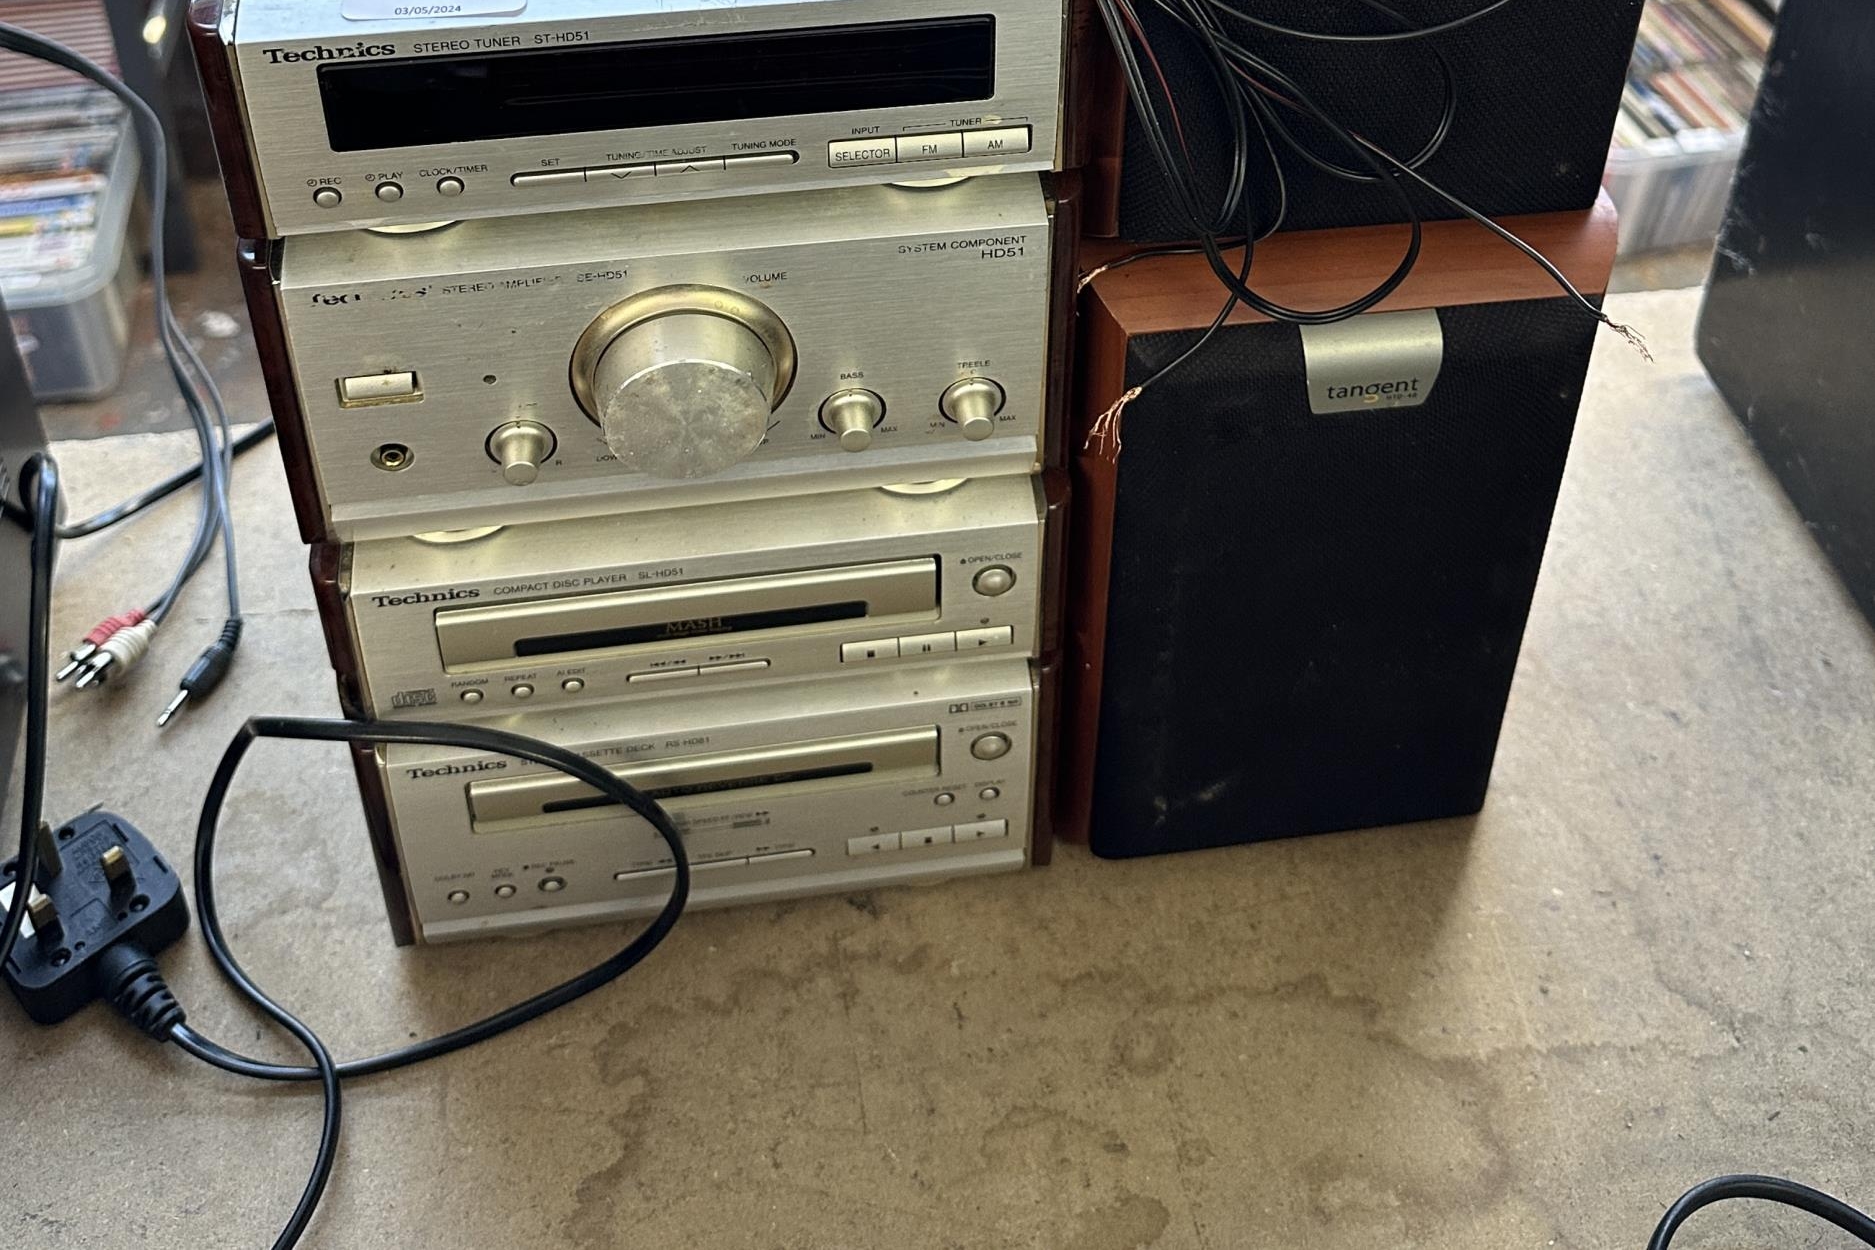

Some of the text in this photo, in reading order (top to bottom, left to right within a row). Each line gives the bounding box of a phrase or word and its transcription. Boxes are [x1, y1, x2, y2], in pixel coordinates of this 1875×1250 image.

[394, 5, 462, 16] 03/05/2024
[262, 30, 590, 64] Technics STEREO TUNER ST-HD51
[949, 117, 982, 128] TUNER
[851, 125, 880, 135] INPUT
[731, 138, 797, 151] TUNING MODE
[921, 144, 938, 154] FM
[987, 139, 1004, 150] AM
[835, 148, 891, 162] SELECTOR
[541, 158, 561, 167] SET
[378, 171, 404, 181] PLAY
[419, 164, 488, 177] CLOCK/TIMER
[320, 177, 342, 185] REC
[898, 235, 1027, 254] SYSTEM COMPONENT
[981, 246, 1026, 259] HD51
[840, 371, 864, 380] BASS
[1327, 377, 1419, 404] tangent
[968, 552, 1023, 564] OPEN/CLOSE
[372, 568, 684, 608] Technics COMPACT DISC PLAYER SL-HD51
[666, 617, 722, 633] MASH
[504, 672, 537, 682] REPEAT
[451, 678, 489, 689] RANDOM
[405, 759, 508, 779] Technics
[626, 742, 656, 754] DECK
